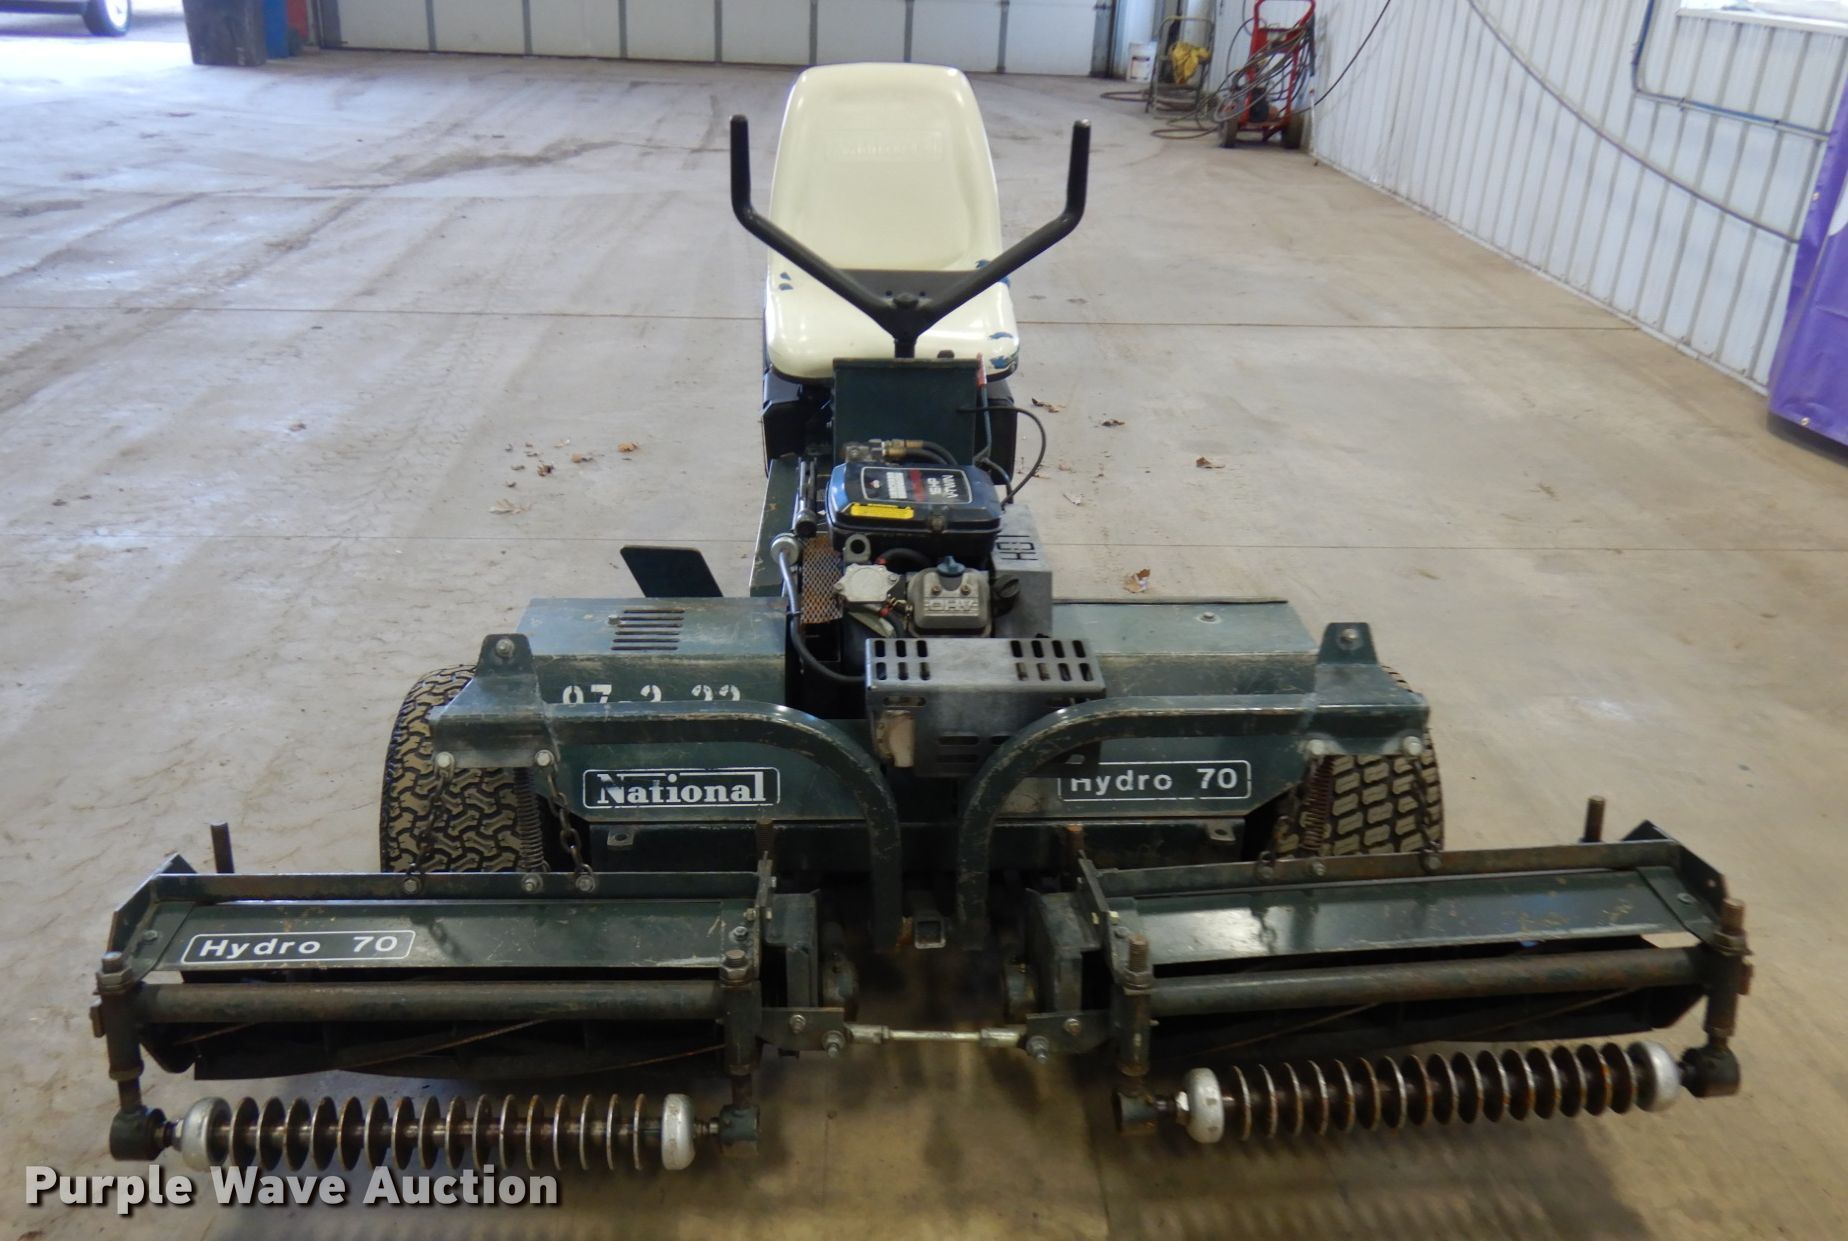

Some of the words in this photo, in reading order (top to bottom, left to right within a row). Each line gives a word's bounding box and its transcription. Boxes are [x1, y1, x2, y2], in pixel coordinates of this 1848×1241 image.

[596, 771, 766, 804] National
[1070, 769, 1174, 796] Hydro
[1196, 767, 1238, 789] 70
[199, 938, 322, 959] Hydro
[352, 935, 398, 953] 70
